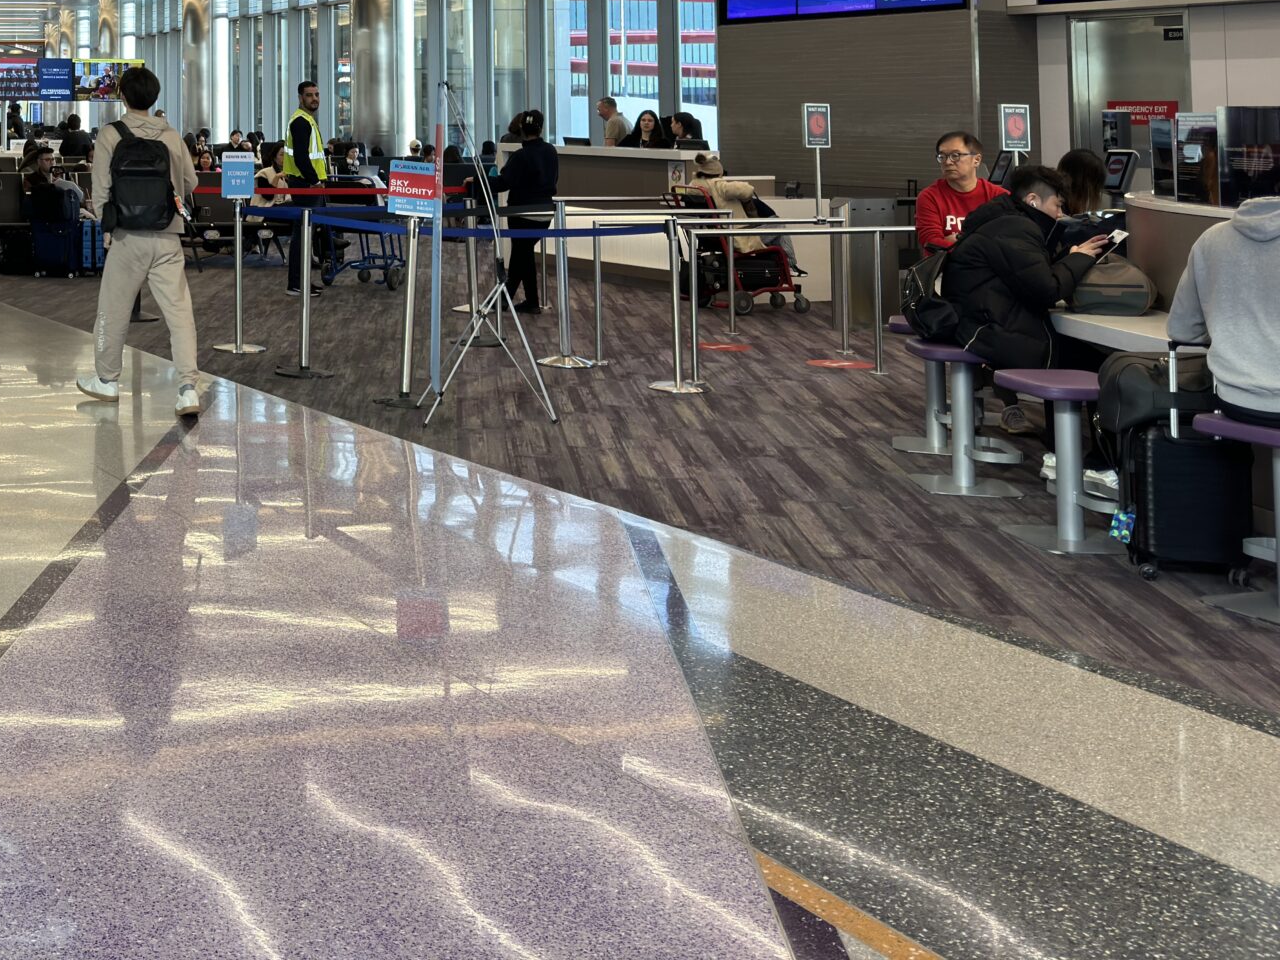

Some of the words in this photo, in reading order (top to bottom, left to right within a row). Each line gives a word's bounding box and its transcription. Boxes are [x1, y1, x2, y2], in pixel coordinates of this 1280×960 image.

[1154, 105, 1168, 113] EXIT
[390, 178, 409, 187] SKY
[390, 185, 433, 197] PRIORITY
